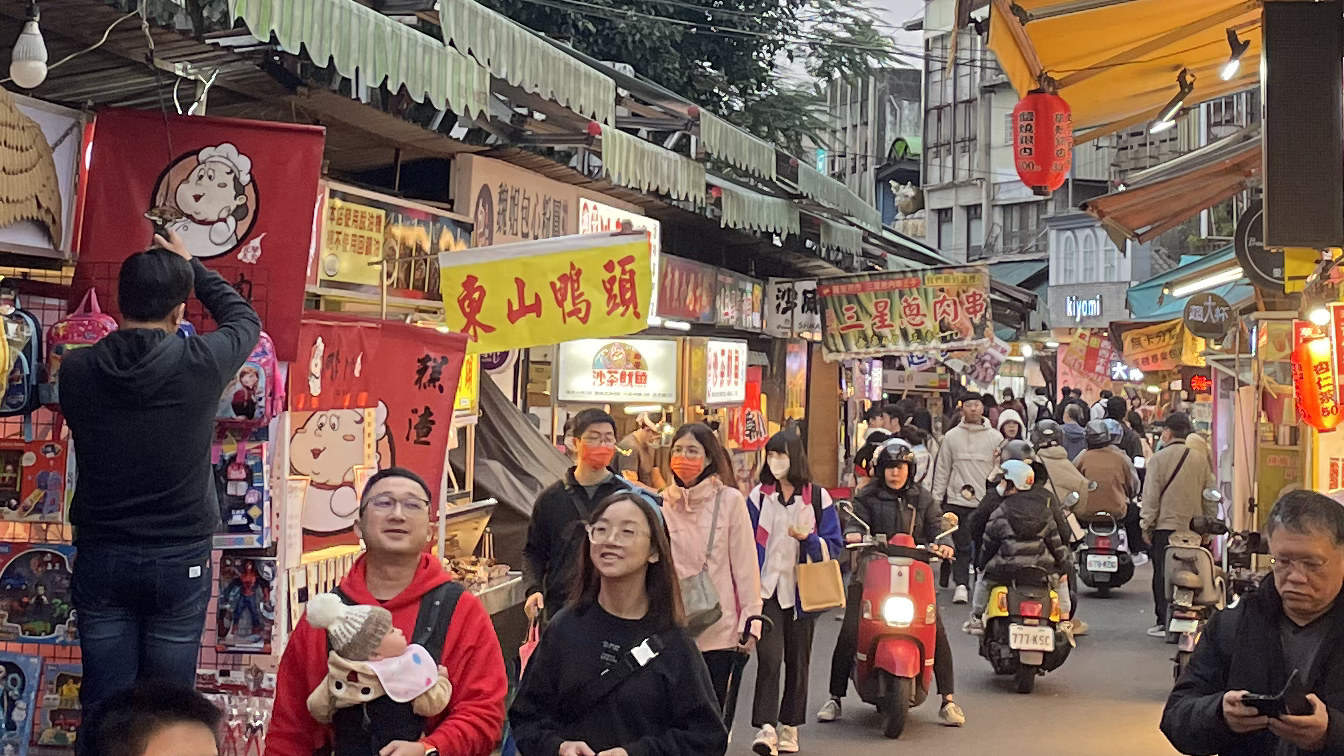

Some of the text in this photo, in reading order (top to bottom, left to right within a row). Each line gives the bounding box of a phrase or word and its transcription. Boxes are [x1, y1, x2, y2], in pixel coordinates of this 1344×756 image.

[457, 255, 641, 342] 東山鴨頭
[1066, 295, 1102, 322] kiyomi
